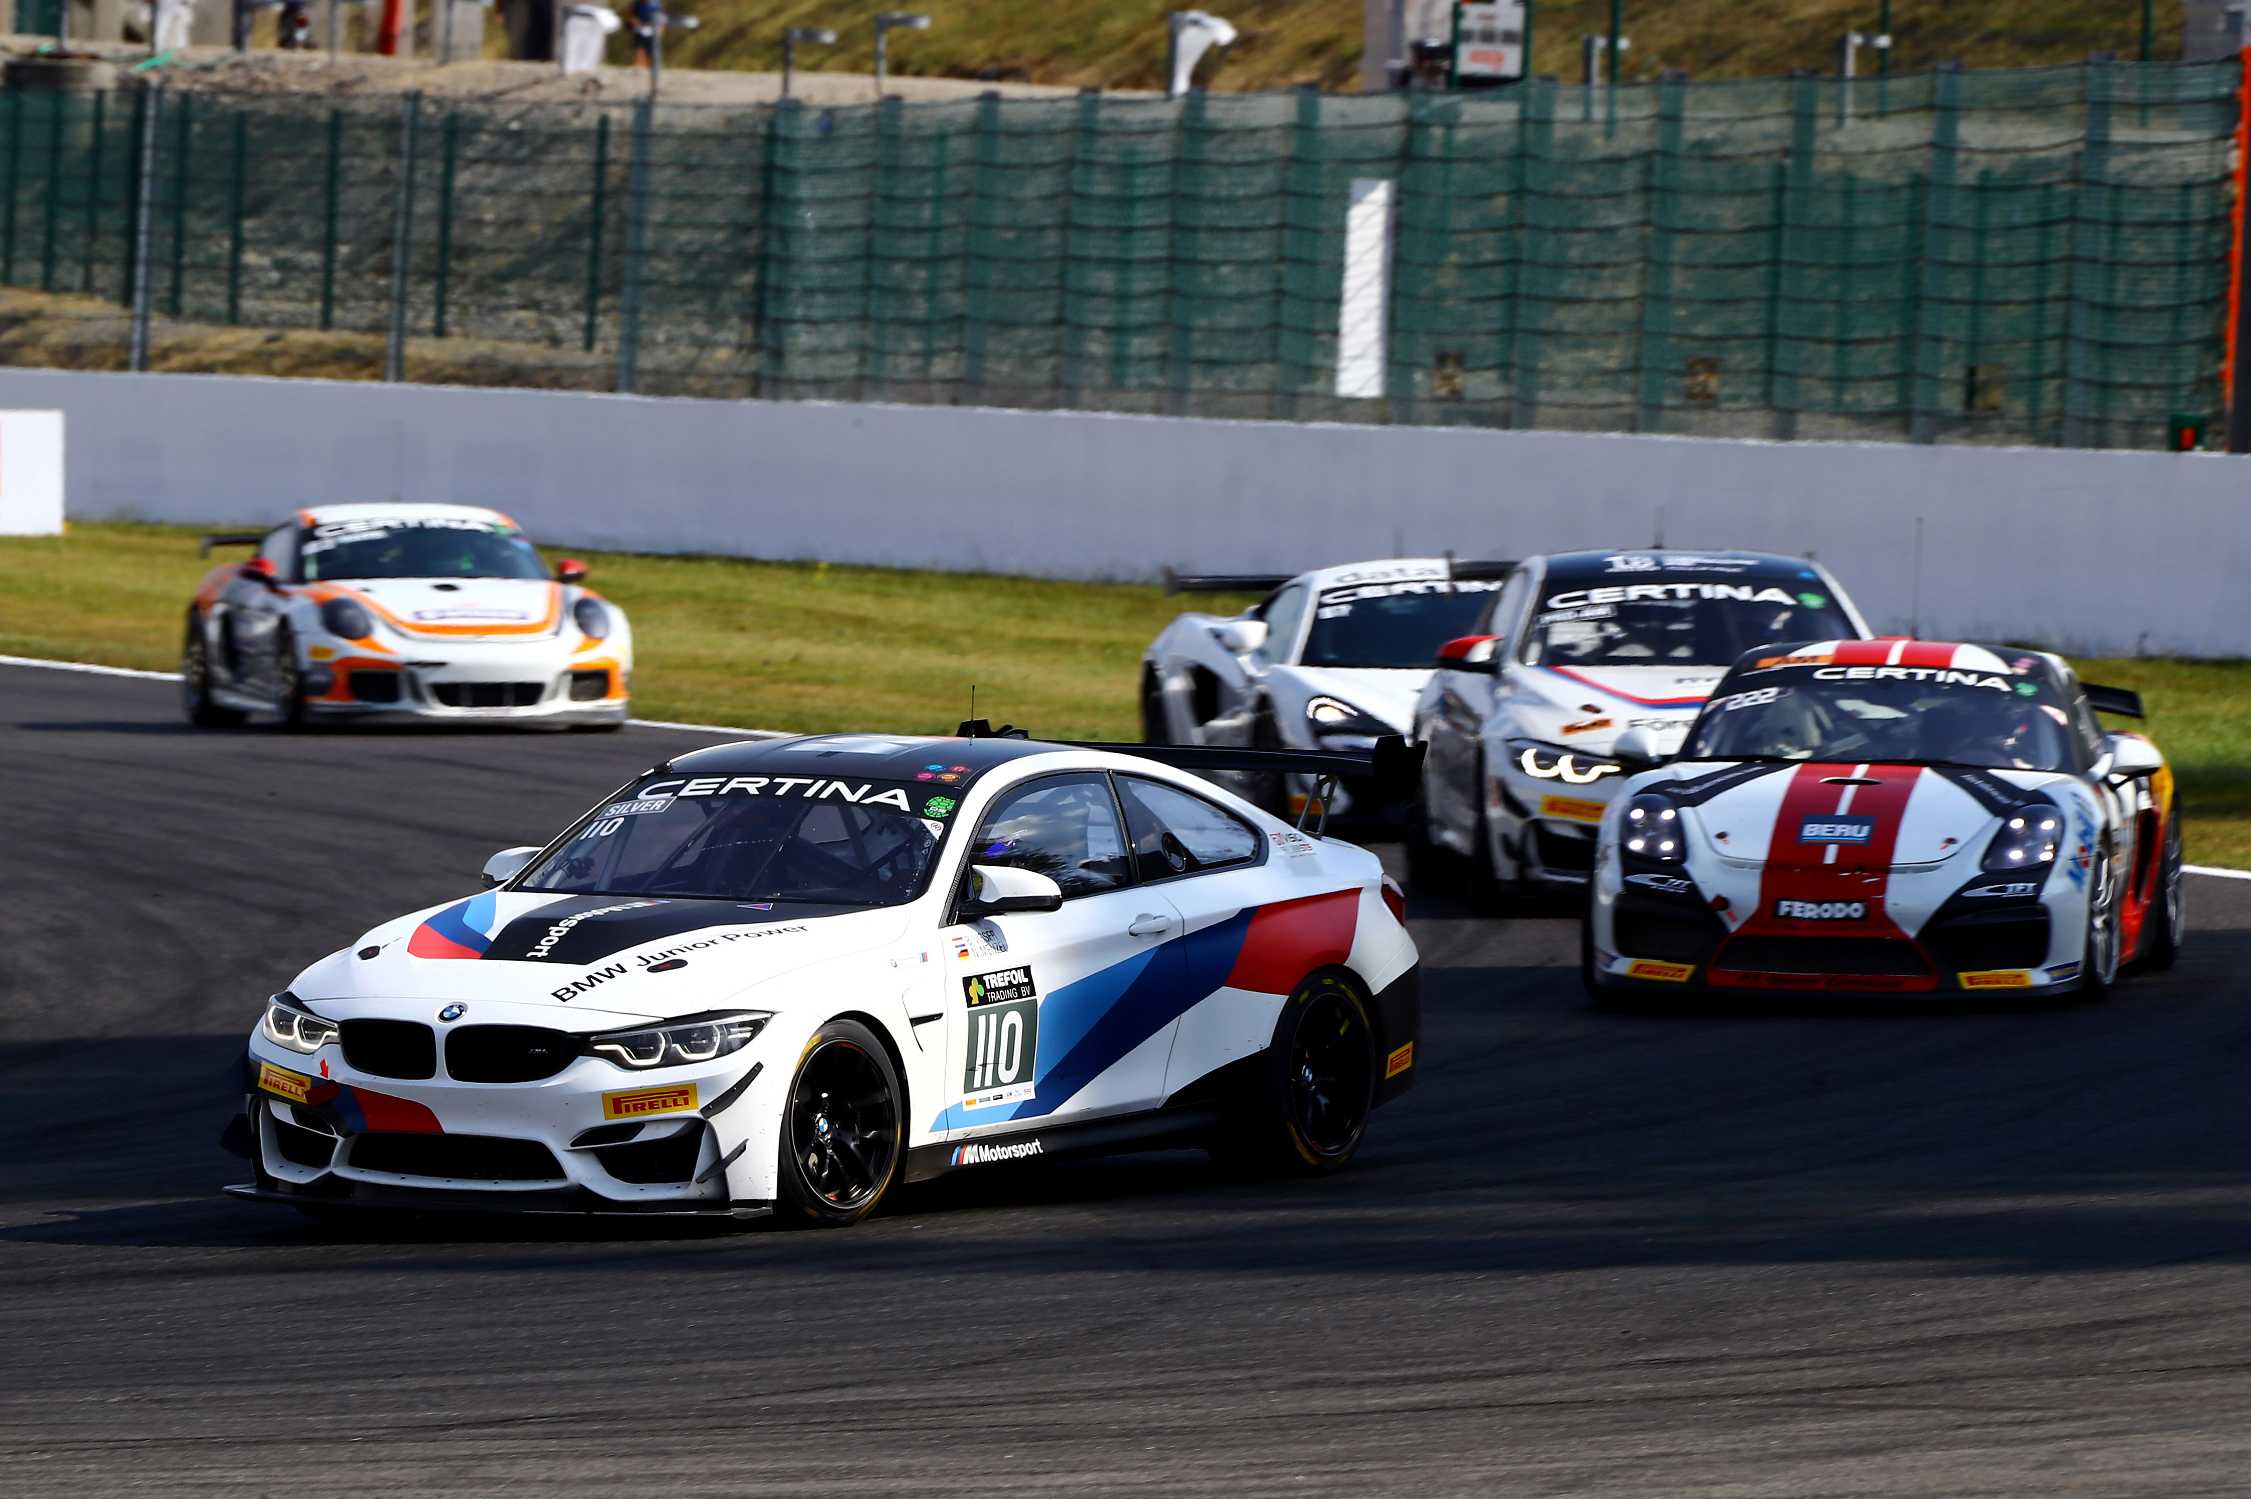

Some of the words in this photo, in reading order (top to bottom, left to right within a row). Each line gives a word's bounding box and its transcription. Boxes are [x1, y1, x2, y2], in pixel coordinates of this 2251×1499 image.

[1547, 584, 1799, 609] CERTINA
[1812, 666, 2013, 693] CERTINA
[1726, 686, 1779, 711] 222
[637, 777, 912, 812] CERTINA
[607, 798, 666, 817] SILVER
[580, 817, 624, 840] 110
[1802, 823, 1871, 838] BERU
[1777, 900, 1865, 919] FERODO
[551, 962, 627, 1003] BMW
[637, 937, 719, 968] Junior
[722, 924, 809, 941] Power
[983, 969, 1029, 989] TREFOIL
[986, 988, 1019, 1003] TRADING
[1020, 985, 1031, 997] BV
[973, 1010, 1024, 1089] 110
[262, 1069, 308, 1099] PIRELLI
[612, 1087, 690, 1115] PIRELLI
[978, 1138, 1044, 1163] Motorsport
